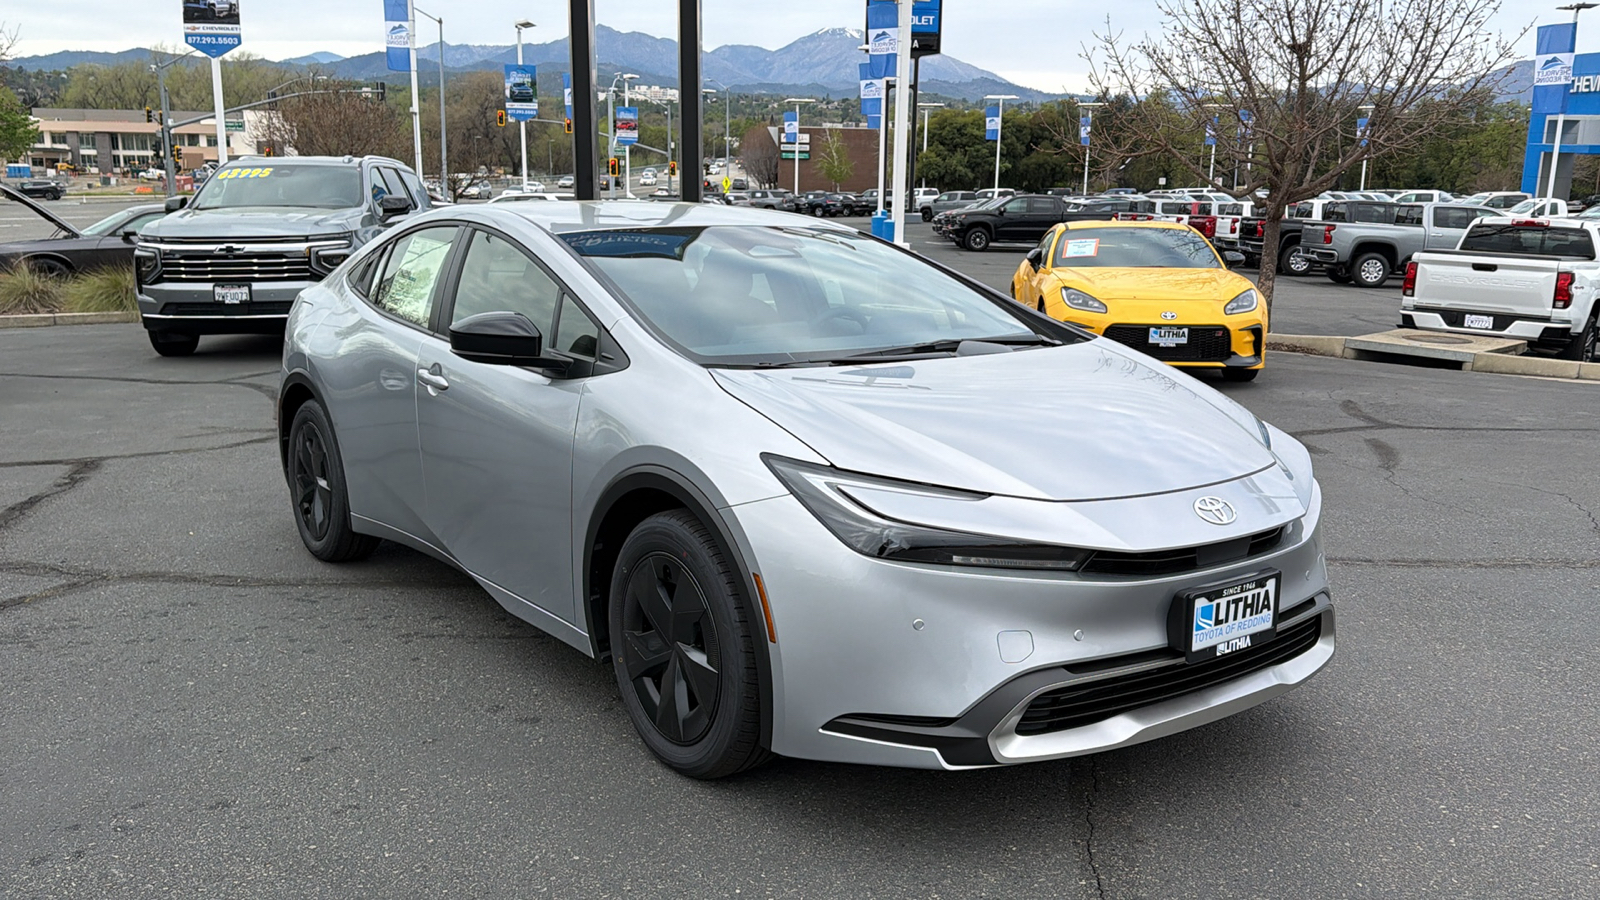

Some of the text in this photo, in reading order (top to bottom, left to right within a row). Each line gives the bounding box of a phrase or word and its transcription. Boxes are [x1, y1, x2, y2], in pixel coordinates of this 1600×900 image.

[187, 36, 239, 45] 877.293.5503
[1429, 273, 1540, 289] CHEVROLET
[1158, 330, 1187, 338] LITHIA
[1222, 581, 1256, 597] SINCE 1946
[1213, 588, 1271, 627] LITHIA
[1194, 613, 1271, 643] TOYOTA OF REDDING
[1224, 635, 1251, 654] LITHIA
